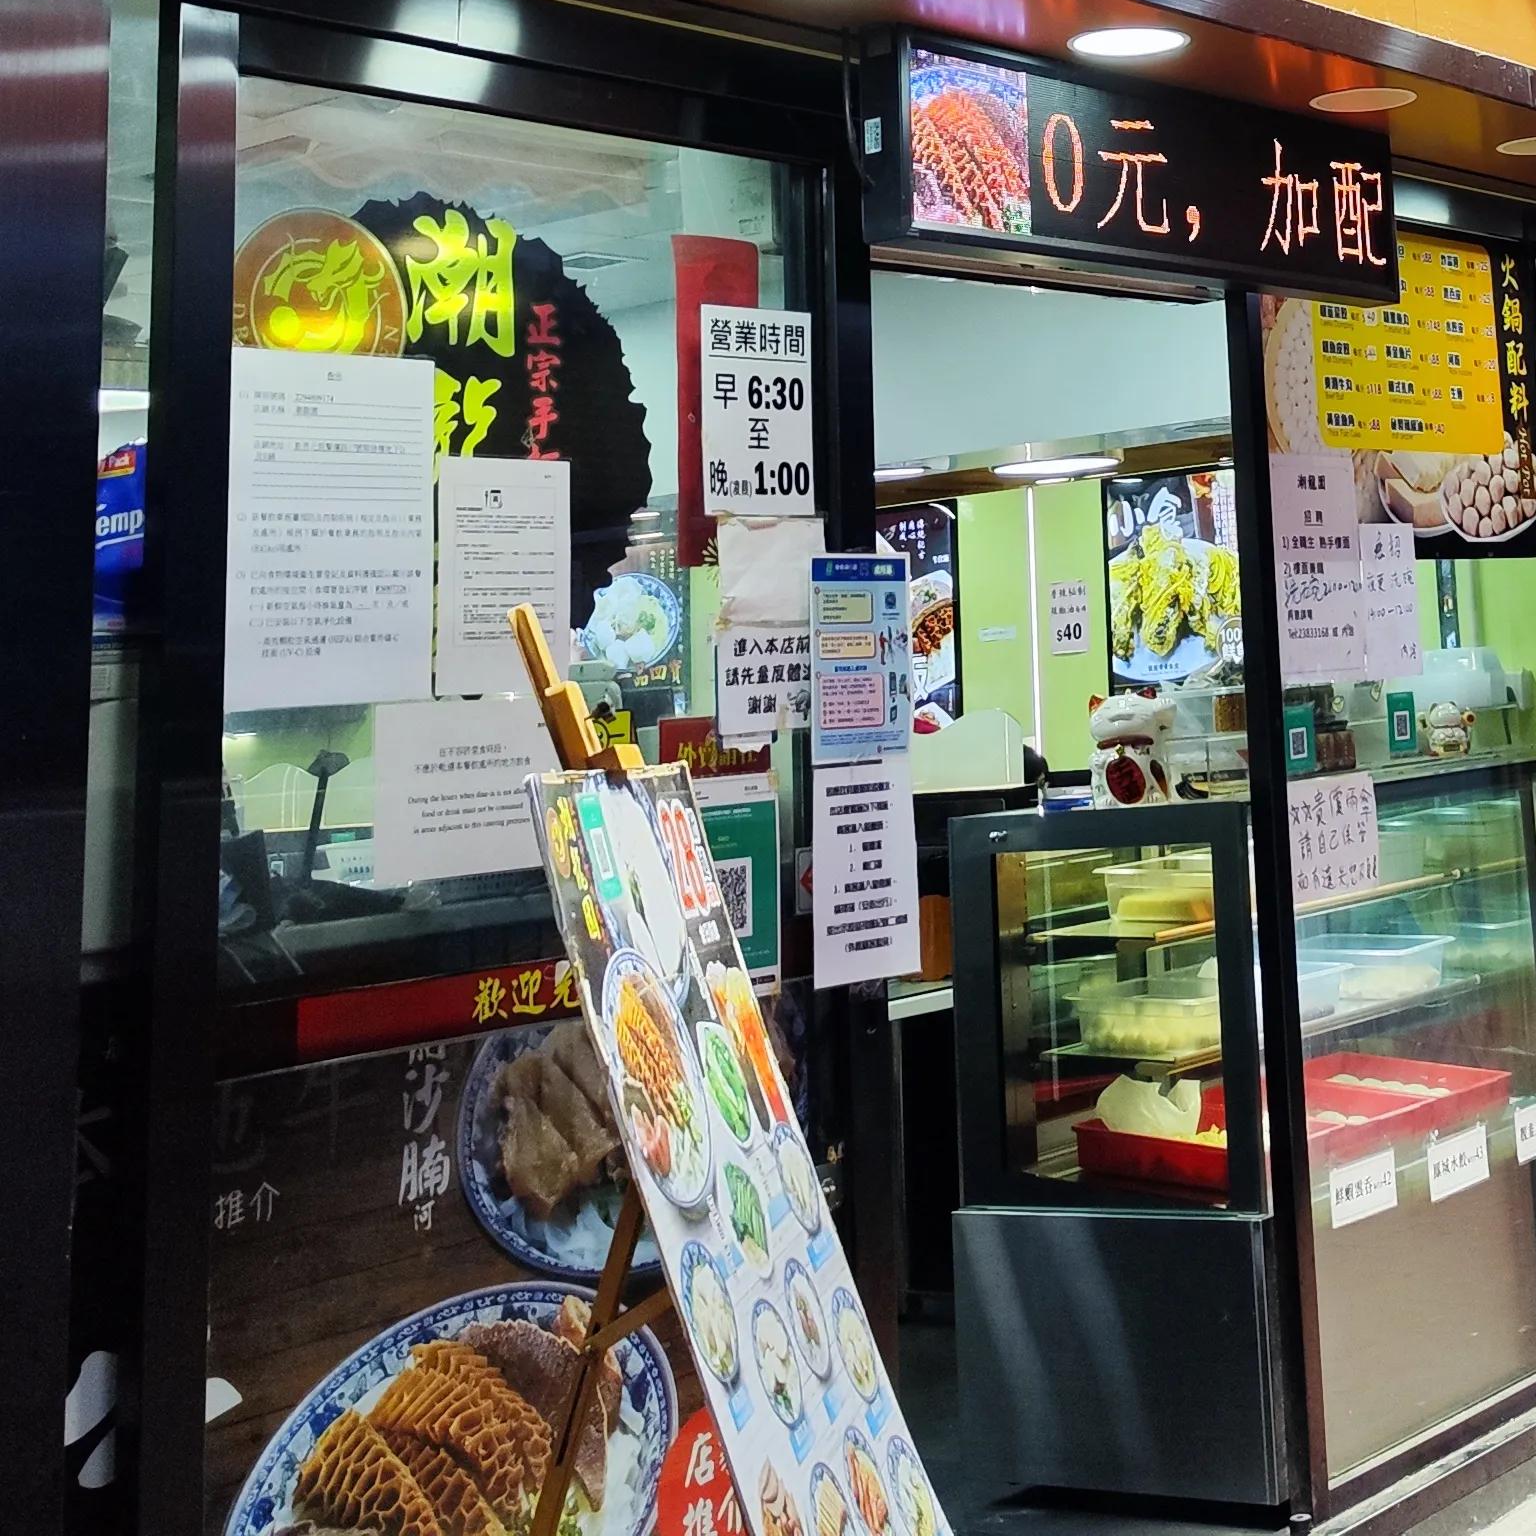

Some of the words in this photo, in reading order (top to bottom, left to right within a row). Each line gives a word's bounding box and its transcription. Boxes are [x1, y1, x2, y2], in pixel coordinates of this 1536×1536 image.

[1260, 138, 1387, 265] 加配
[710, 318, 805, 356] 營業時間
[1500, 253, 1530, 423] 火鍋配料
[713, 373, 738, 409] 早
[748, 375, 804, 411] 6:30
[748, 417, 770, 450] 至
[754, 461, 810, 496] 1:00
[1056, 622, 1082, 642] $40
[747, 693, 777, 715] 謝謝
[214, 1181, 281, 1230] 推介
